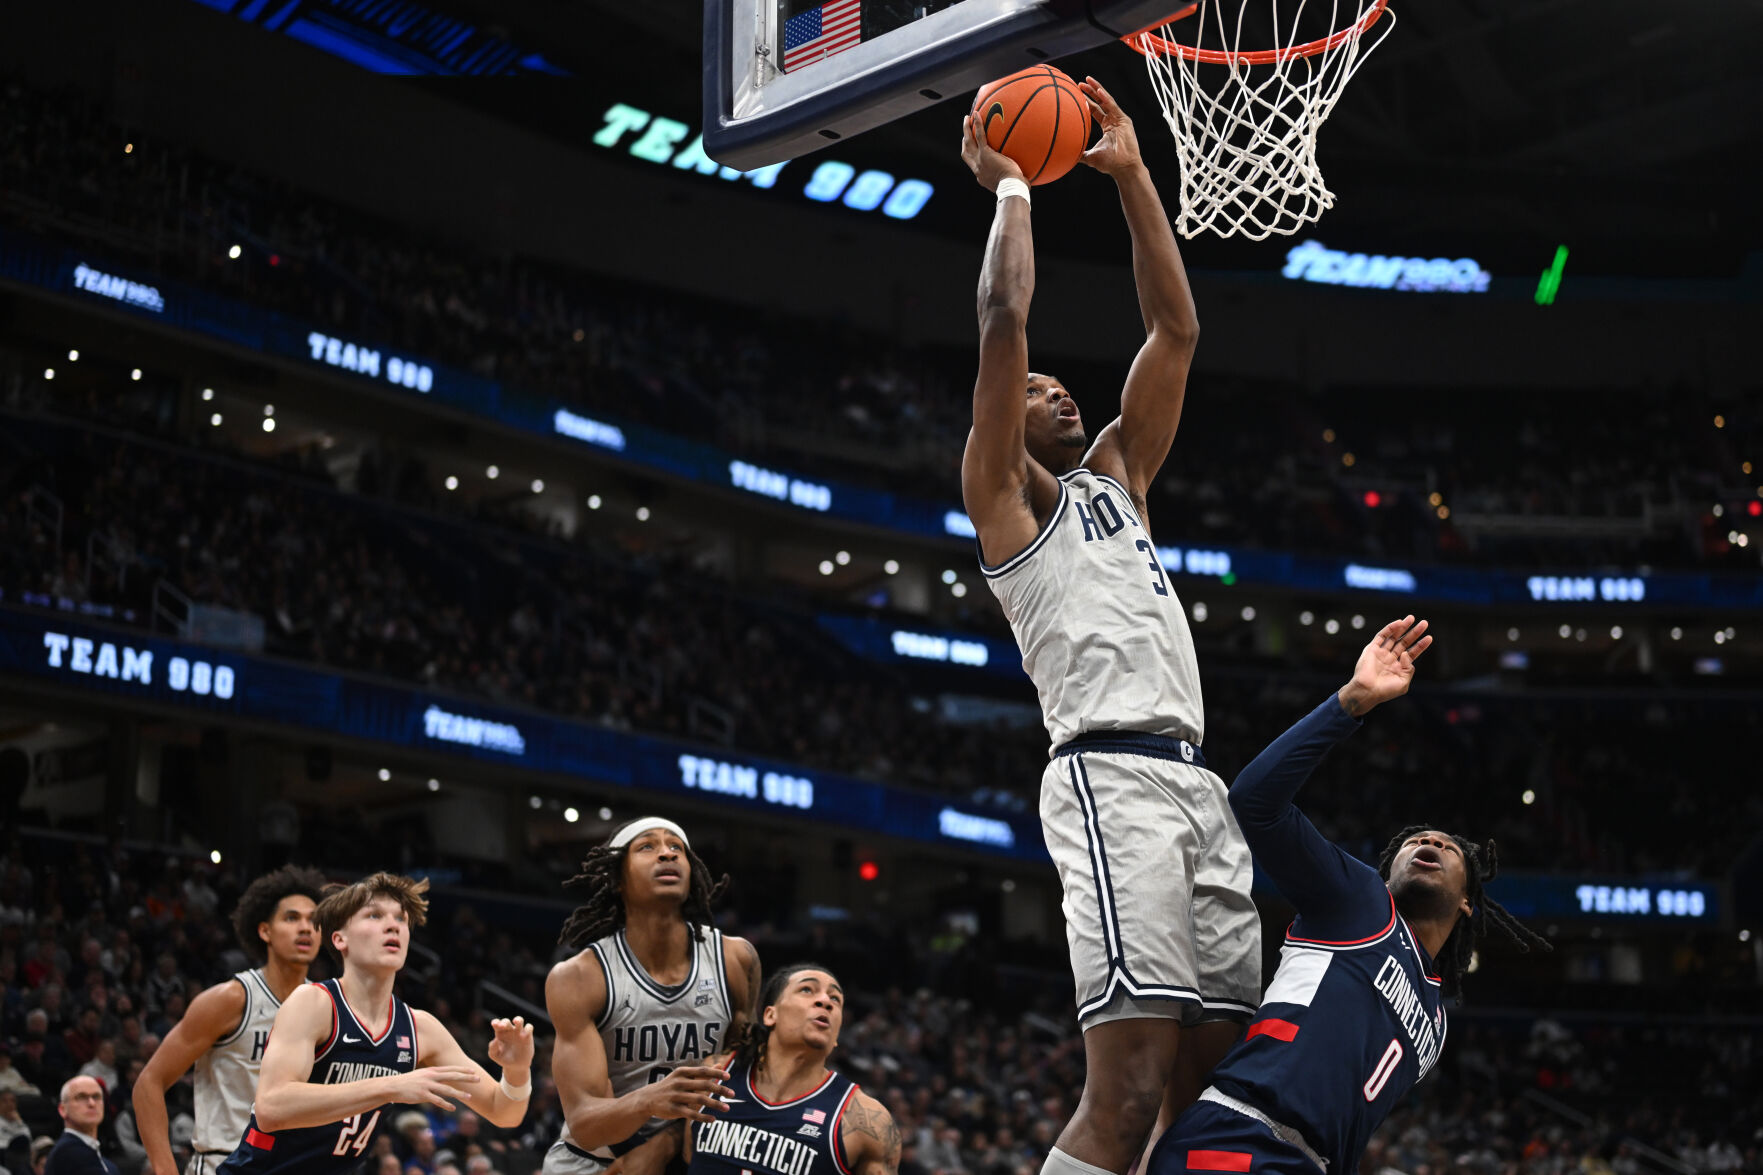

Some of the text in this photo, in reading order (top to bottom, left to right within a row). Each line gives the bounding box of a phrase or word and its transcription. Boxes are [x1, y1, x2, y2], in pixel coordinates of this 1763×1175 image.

[804, 161, 934, 220] 980
[308, 332, 380, 377] TEAM
[43, 631, 235, 699] TEAM 980
[678, 754, 758, 799] TEAM
[1575, 885, 1651, 914] TEAM
[614, 1023, 721, 1062] HOYAS
[1363, 1038, 1403, 1102] 0
[333, 1110, 382, 1157] 24
[696, 1119, 818, 1175] CONNECTICUT
